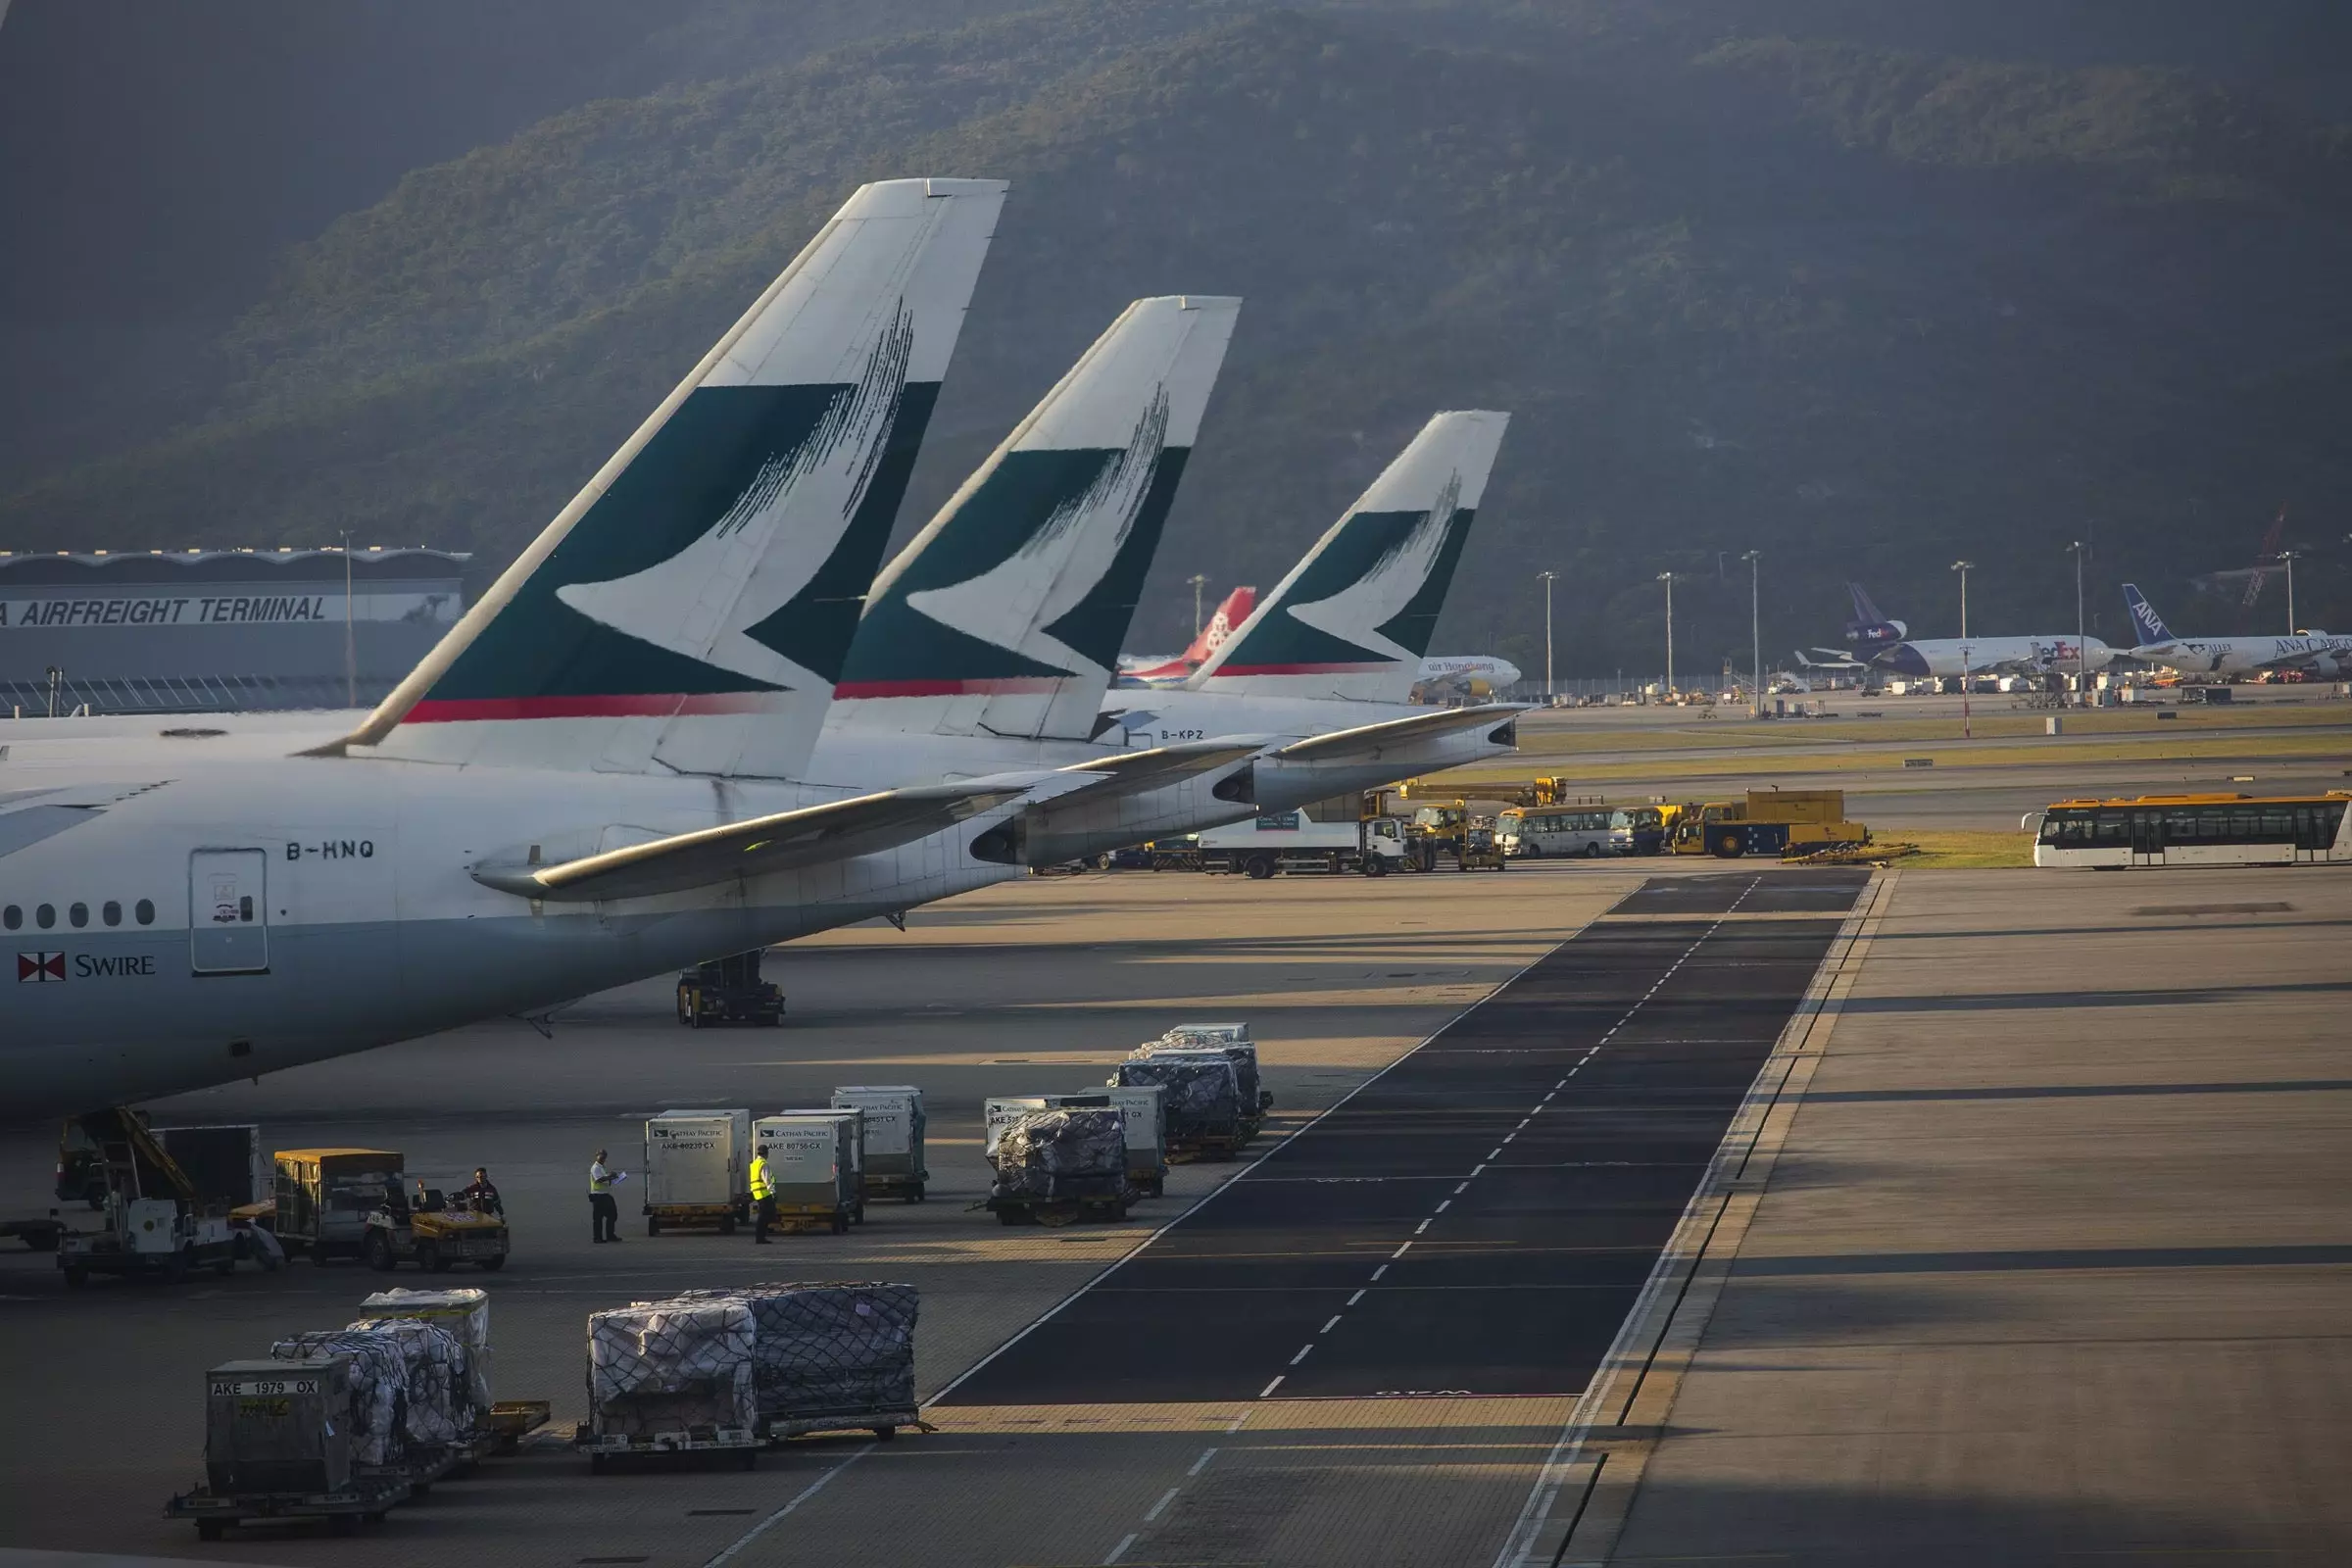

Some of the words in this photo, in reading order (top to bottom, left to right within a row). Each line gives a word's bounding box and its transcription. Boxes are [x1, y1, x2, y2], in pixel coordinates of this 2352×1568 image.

[20, 600, 189, 625] AIRFREIGHT
[199, 598, 325, 622] TERMINAL
[2132, 601, 2163, 637] ANA
[2274, 639, 2305, 658] ANA
[1161, 730, 1204, 740] B-KPZ
[286, 840, 374, 860] B-HNQ
[214, 1383, 241, 1396] AKE
[255, 1382, 284, 1394] 1979
[296, 1381, 316, 1394] OX
